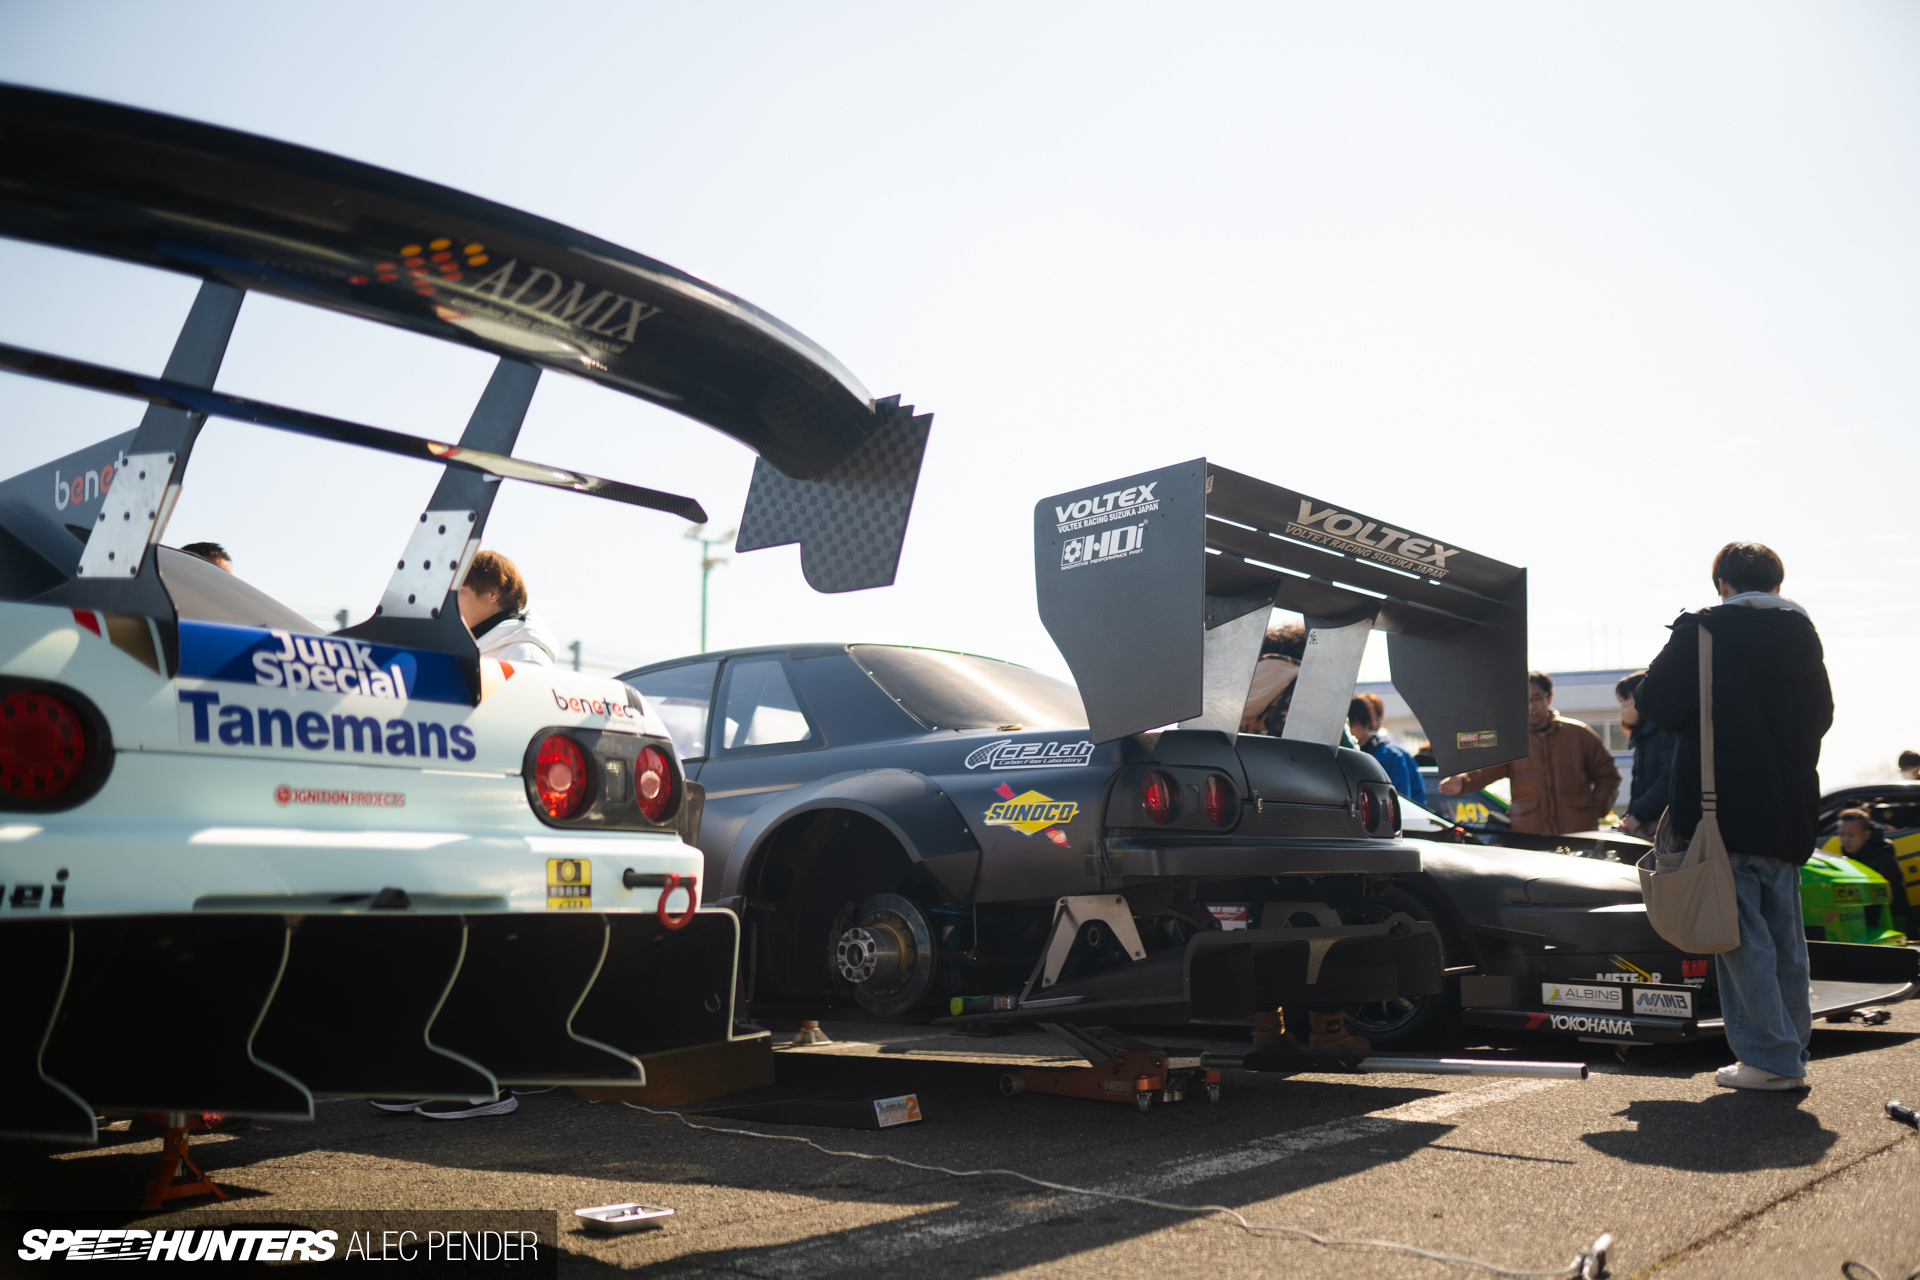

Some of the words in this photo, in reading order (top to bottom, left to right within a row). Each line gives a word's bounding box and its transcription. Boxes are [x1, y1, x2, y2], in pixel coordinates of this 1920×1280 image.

[470, 258, 663, 343] ADMIX
[1055, 482, 1158, 523] VOLTEX
[1058, 521, 1083, 534] VOLTEX
[1083, 514, 1109, 528] RACING
[1109, 509, 1136, 522] SUZUKA
[1137, 502, 1159, 515] JAPAN
[1297, 499, 1460, 569] VOLTEX
[1061, 560, 1089, 571] INNOVATIVE
[1090, 552, 1128, 565] PERFORMANCE
[1284, 525, 1328, 545] VOLTEX
[1329, 540, 1371, 558] RACING
[1371, 552, 1412, 571] SUZUKA
[1412, 565, 1447, 580] JAPAN
[271, 630, 380, 669] Junk
[252, 650, 408, 700] Special
[552, 688, 634, 719] benetec
[178, 688, 477, 763] Tanemans
[994, 743, 1043, 759] CF
[1043, 741, 1095, 758] Lab
[1043, 757, 1083, 765] Laboratory
[293, 787, 350, 805] IGNITION
[350, 789, 406, 808] PROJECTS
[987, 803, 1076, 822] SUNOCO
[1565, 988, 1620, 1001] ALBINS
[1550, 1014, 1634, 1036] YOKOHAMA
